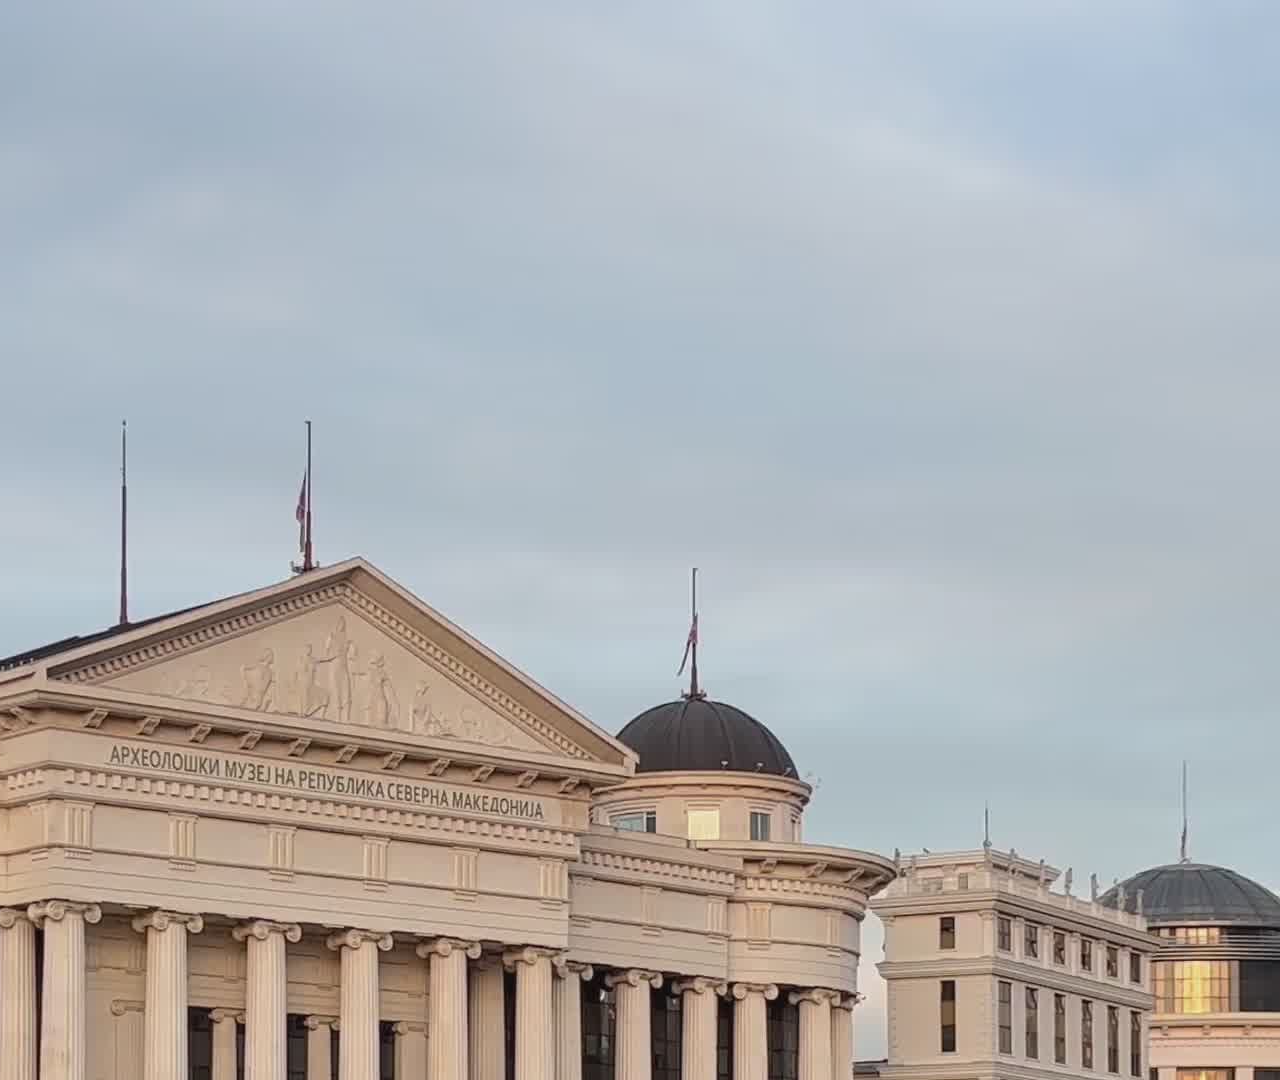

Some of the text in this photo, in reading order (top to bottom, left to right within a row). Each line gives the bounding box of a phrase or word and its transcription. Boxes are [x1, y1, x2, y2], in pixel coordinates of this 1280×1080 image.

[110, 744, 544, 820] АРХЕОЛОШКИ МУЗЕЈ НА РЕПУБЛИКА СЕВЕРНА МАКЕДОНИЈА
